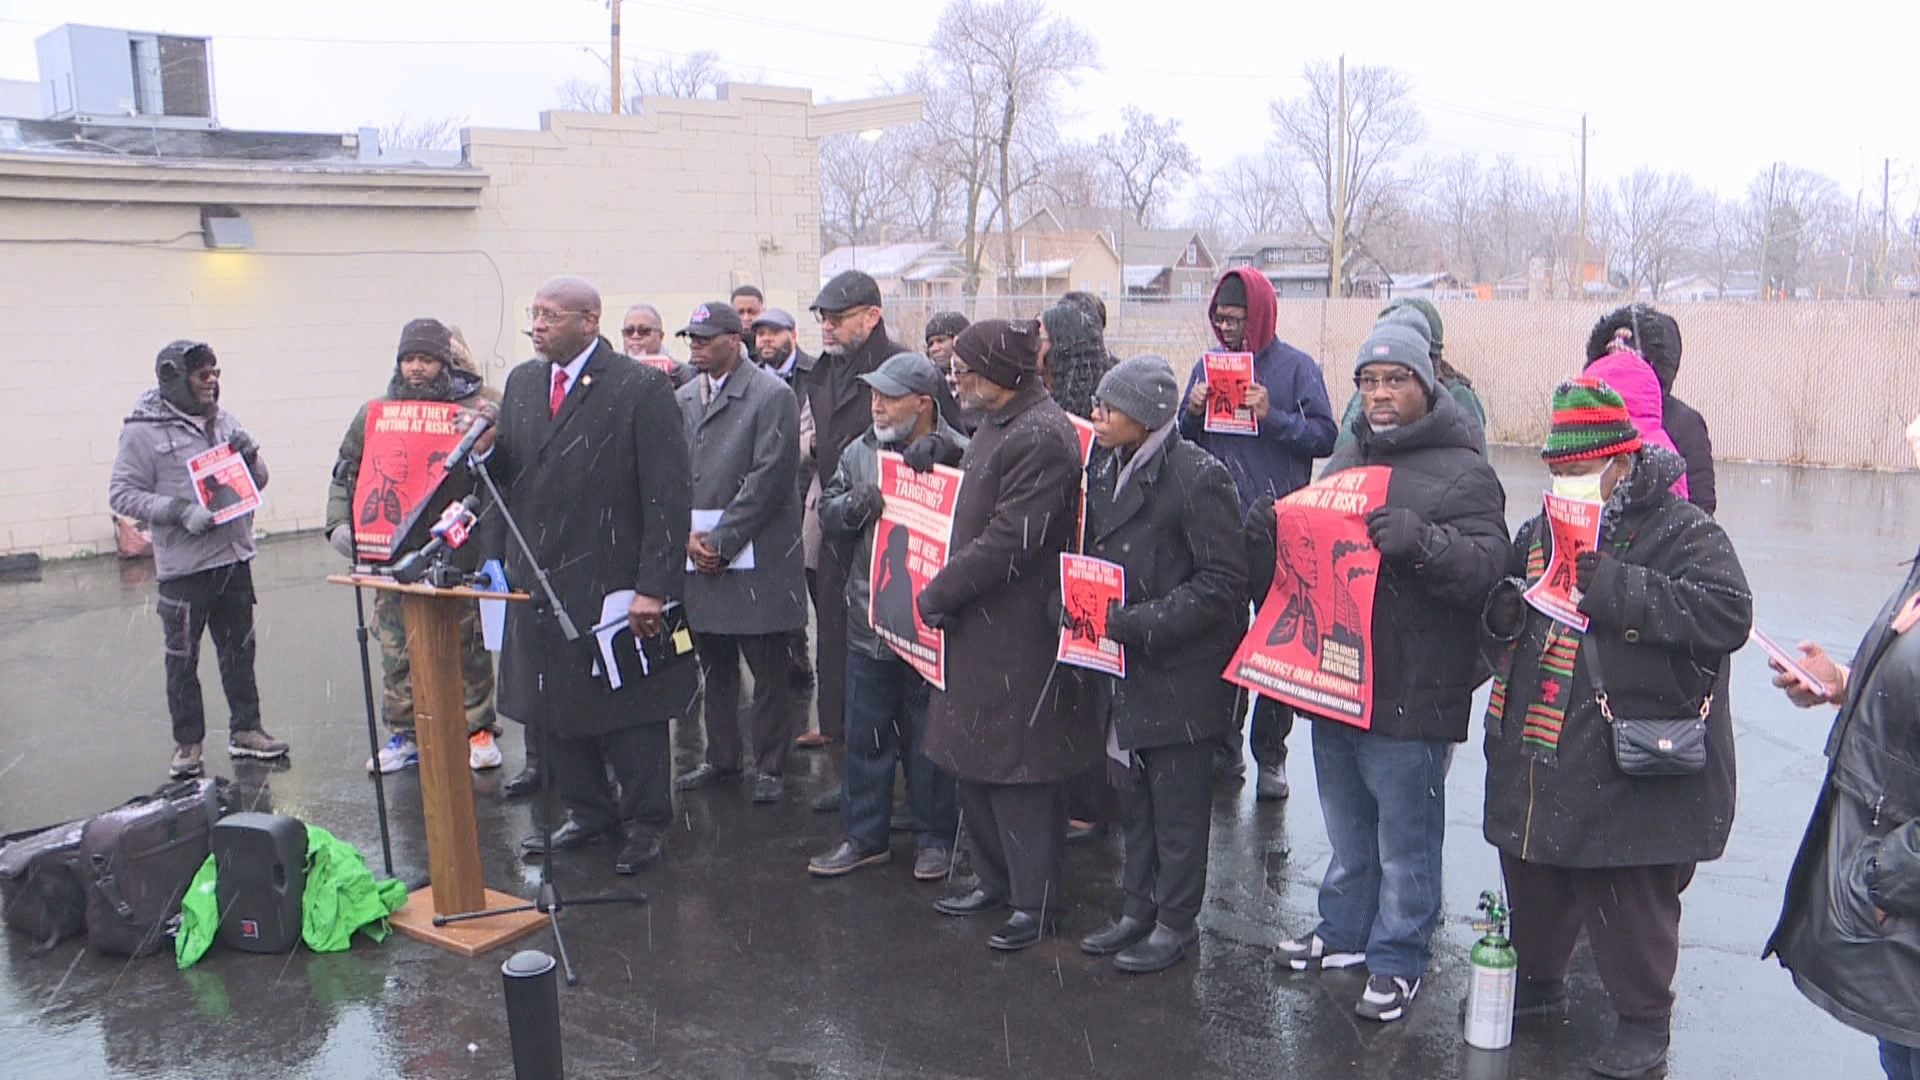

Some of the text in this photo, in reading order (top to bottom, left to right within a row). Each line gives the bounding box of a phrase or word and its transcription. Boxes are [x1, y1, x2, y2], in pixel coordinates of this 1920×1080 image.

[400, 406, 419, 418] ARE
[421, 406, 449, 421] THEY
[375, 419, 409, 432] PUTTING
[409, 420, 424, 433] AT
[1318, 489, 1336, 509] AT
[1332, 491, 1368, 515] RISK?
[909, 535, 922, 554] NOT
[1250, 652, 1359, 698] PROTECT OUR COMMUNITY
